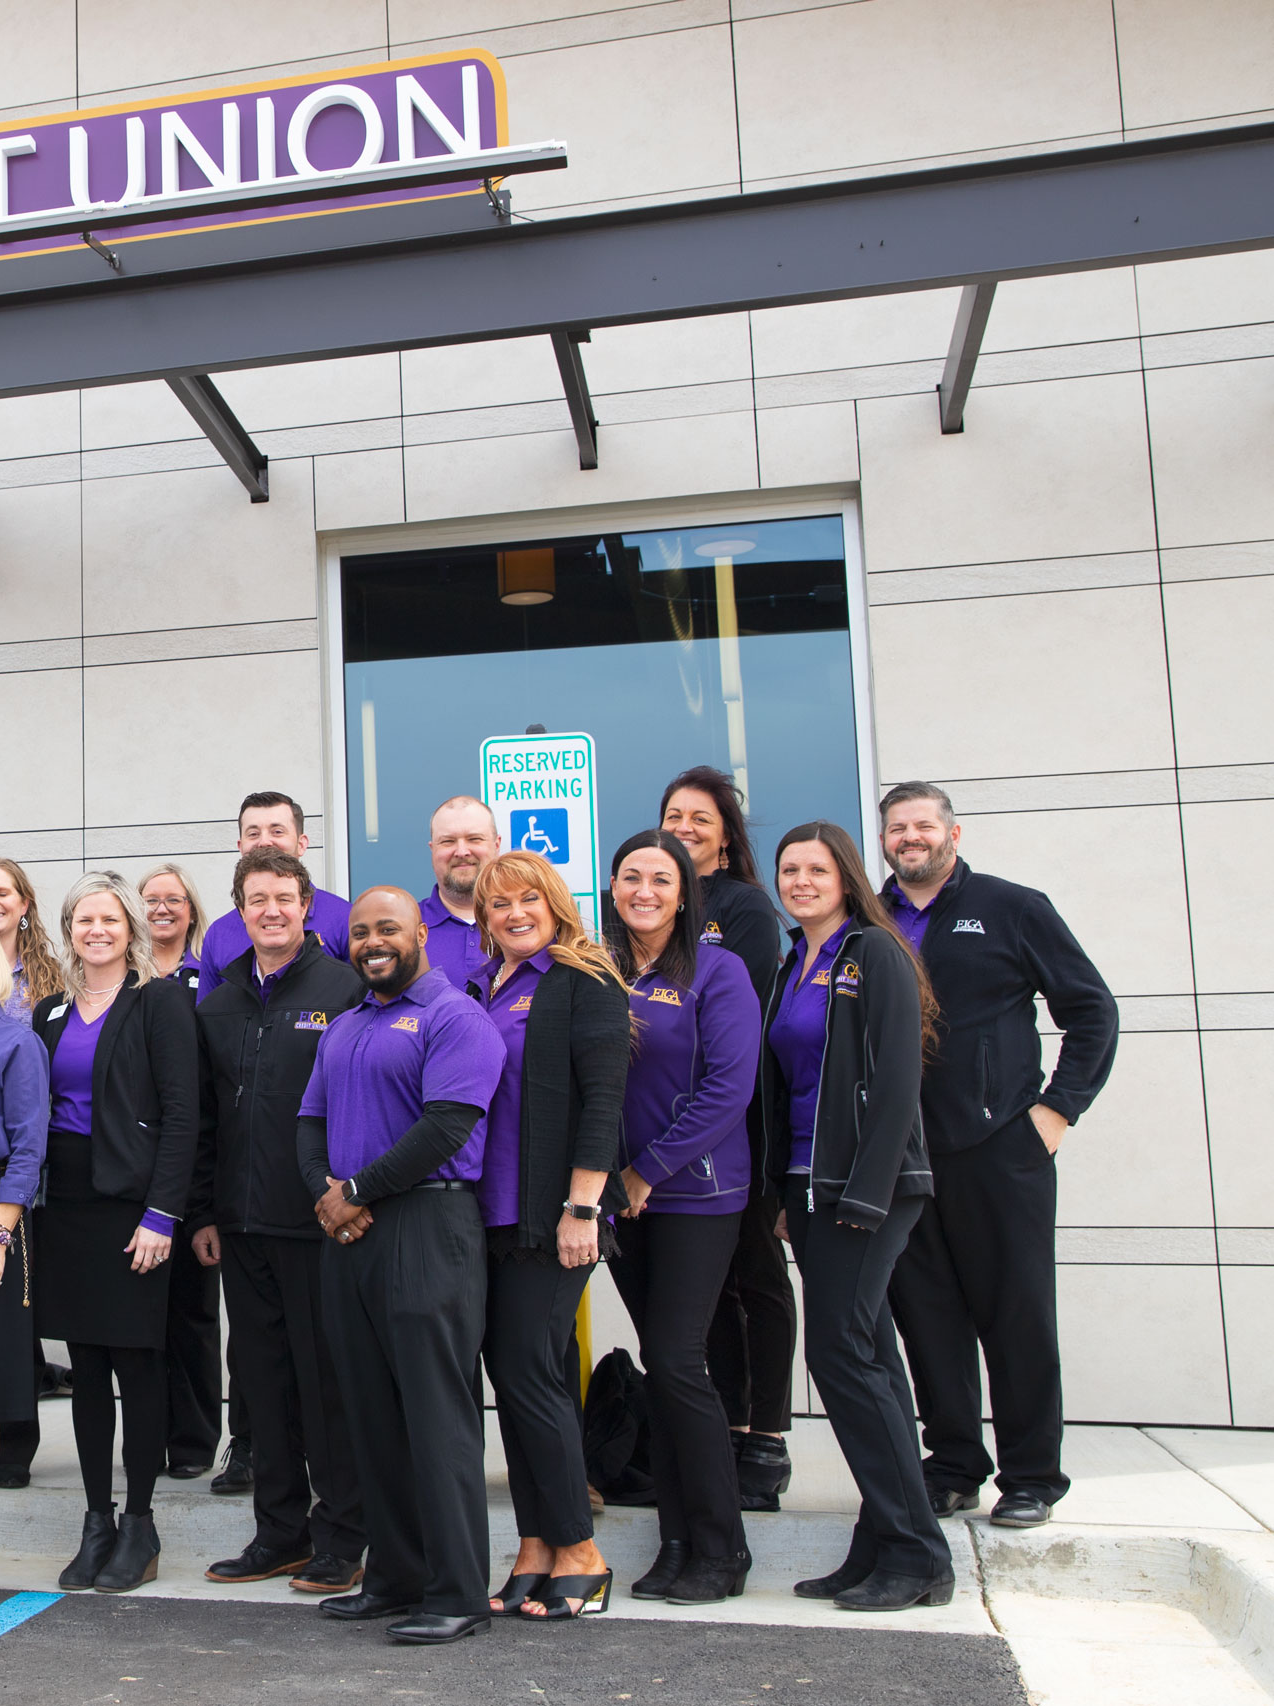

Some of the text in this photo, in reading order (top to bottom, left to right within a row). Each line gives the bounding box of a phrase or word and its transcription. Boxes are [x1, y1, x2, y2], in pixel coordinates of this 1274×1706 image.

[68, 64, 482, 208] UNION
[489, 750, 586, 774] RESERVED
[495, 778, 583, 801] PARKING
